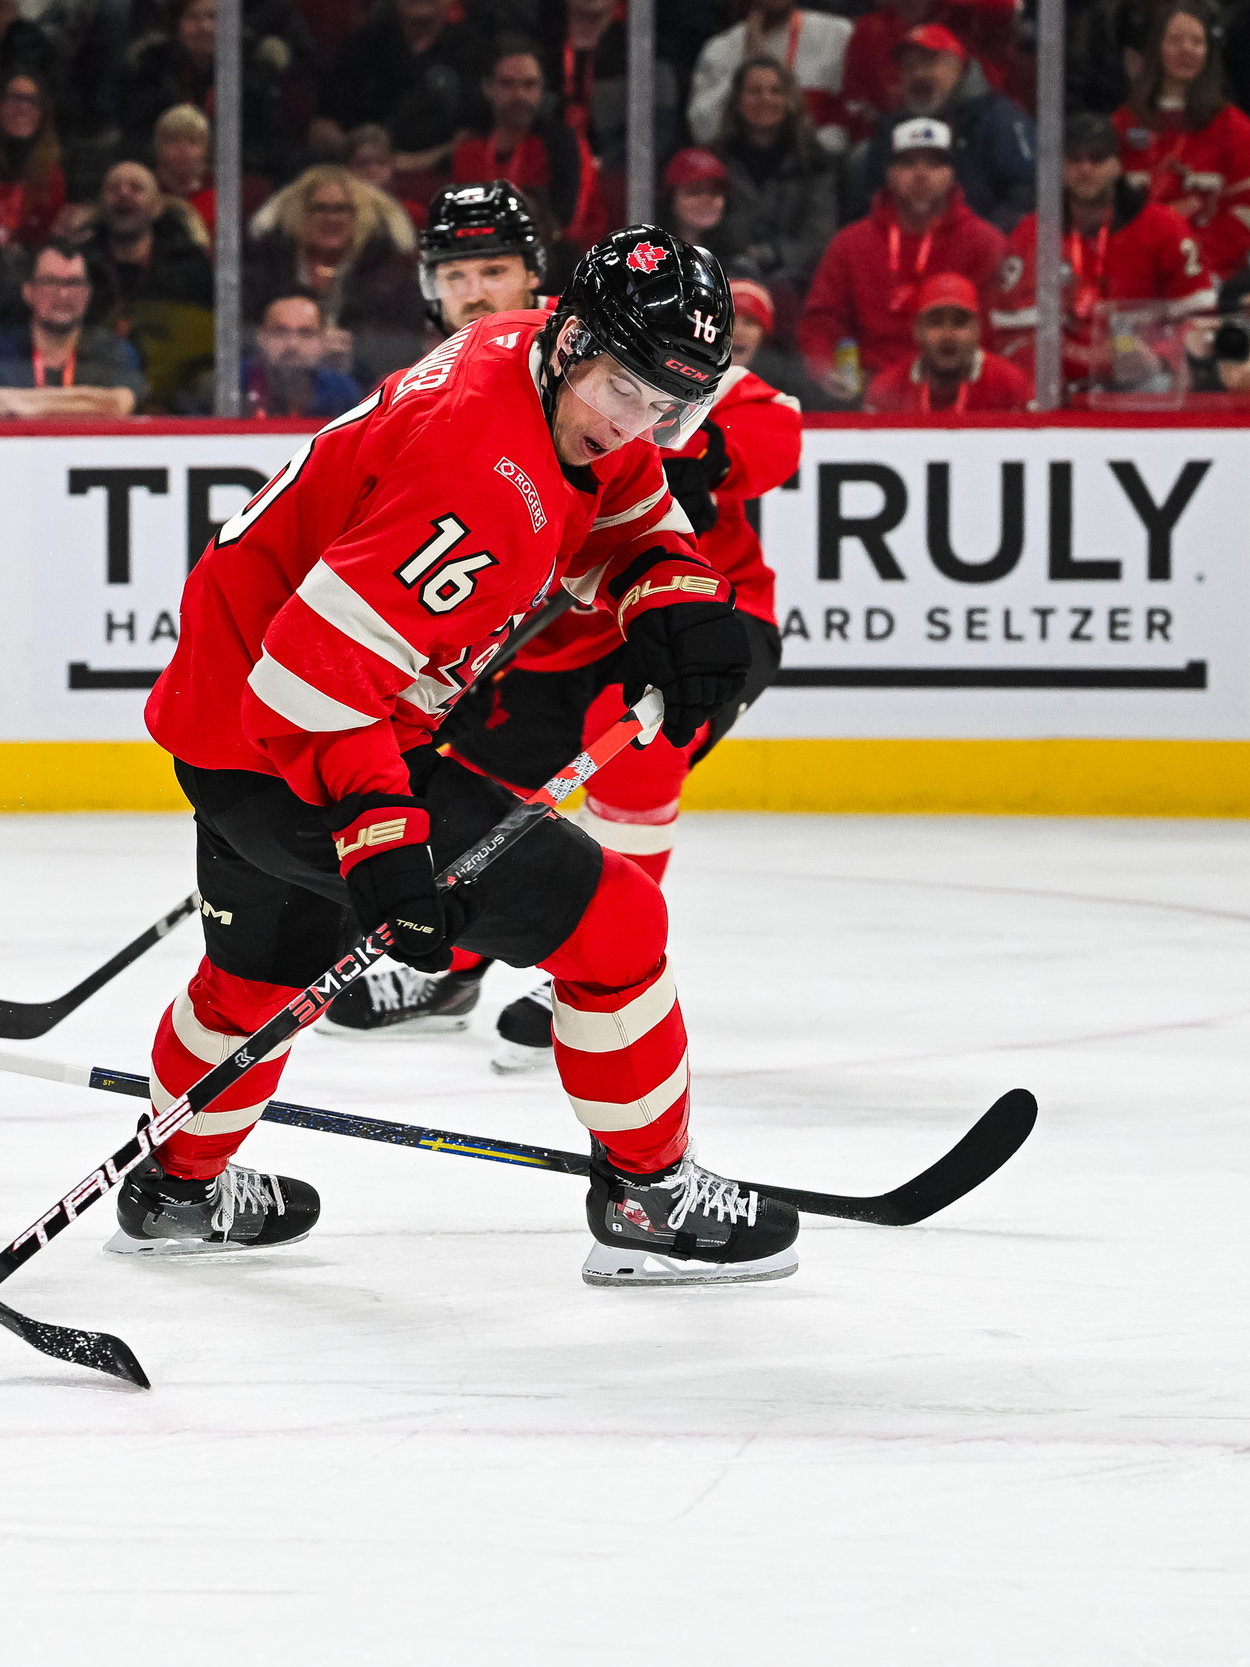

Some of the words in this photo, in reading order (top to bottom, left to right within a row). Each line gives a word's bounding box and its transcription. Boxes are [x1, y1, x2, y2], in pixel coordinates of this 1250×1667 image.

[692, 309, 716, 345] 16
[665, 358, 709, 382] CCM
[513, 472, 545, 528] ROGERS
[744, 459, 1214, 584] RULY
[393, 511, 500, 616] 16
[105, 609, 179, 644] HA
[616, 574, 721, 642] RUE
[778, 606, 897, 642] ARD
[925, 606, 1174, 643] SELTZER
[335, 817, 408, 862] UE
[454, 833, 506, 879] HZRDUS
[395, 918, 436, 935] TRUE
[288, 922, 395, 1024] SMOKE
[12, 1092, 196, 1254] TRUE
[614, 1173, 651, 1192] TRUE
[157, 1191, 193, 1207] TRUE
[585, 1269, 614, 1277] TRUE
